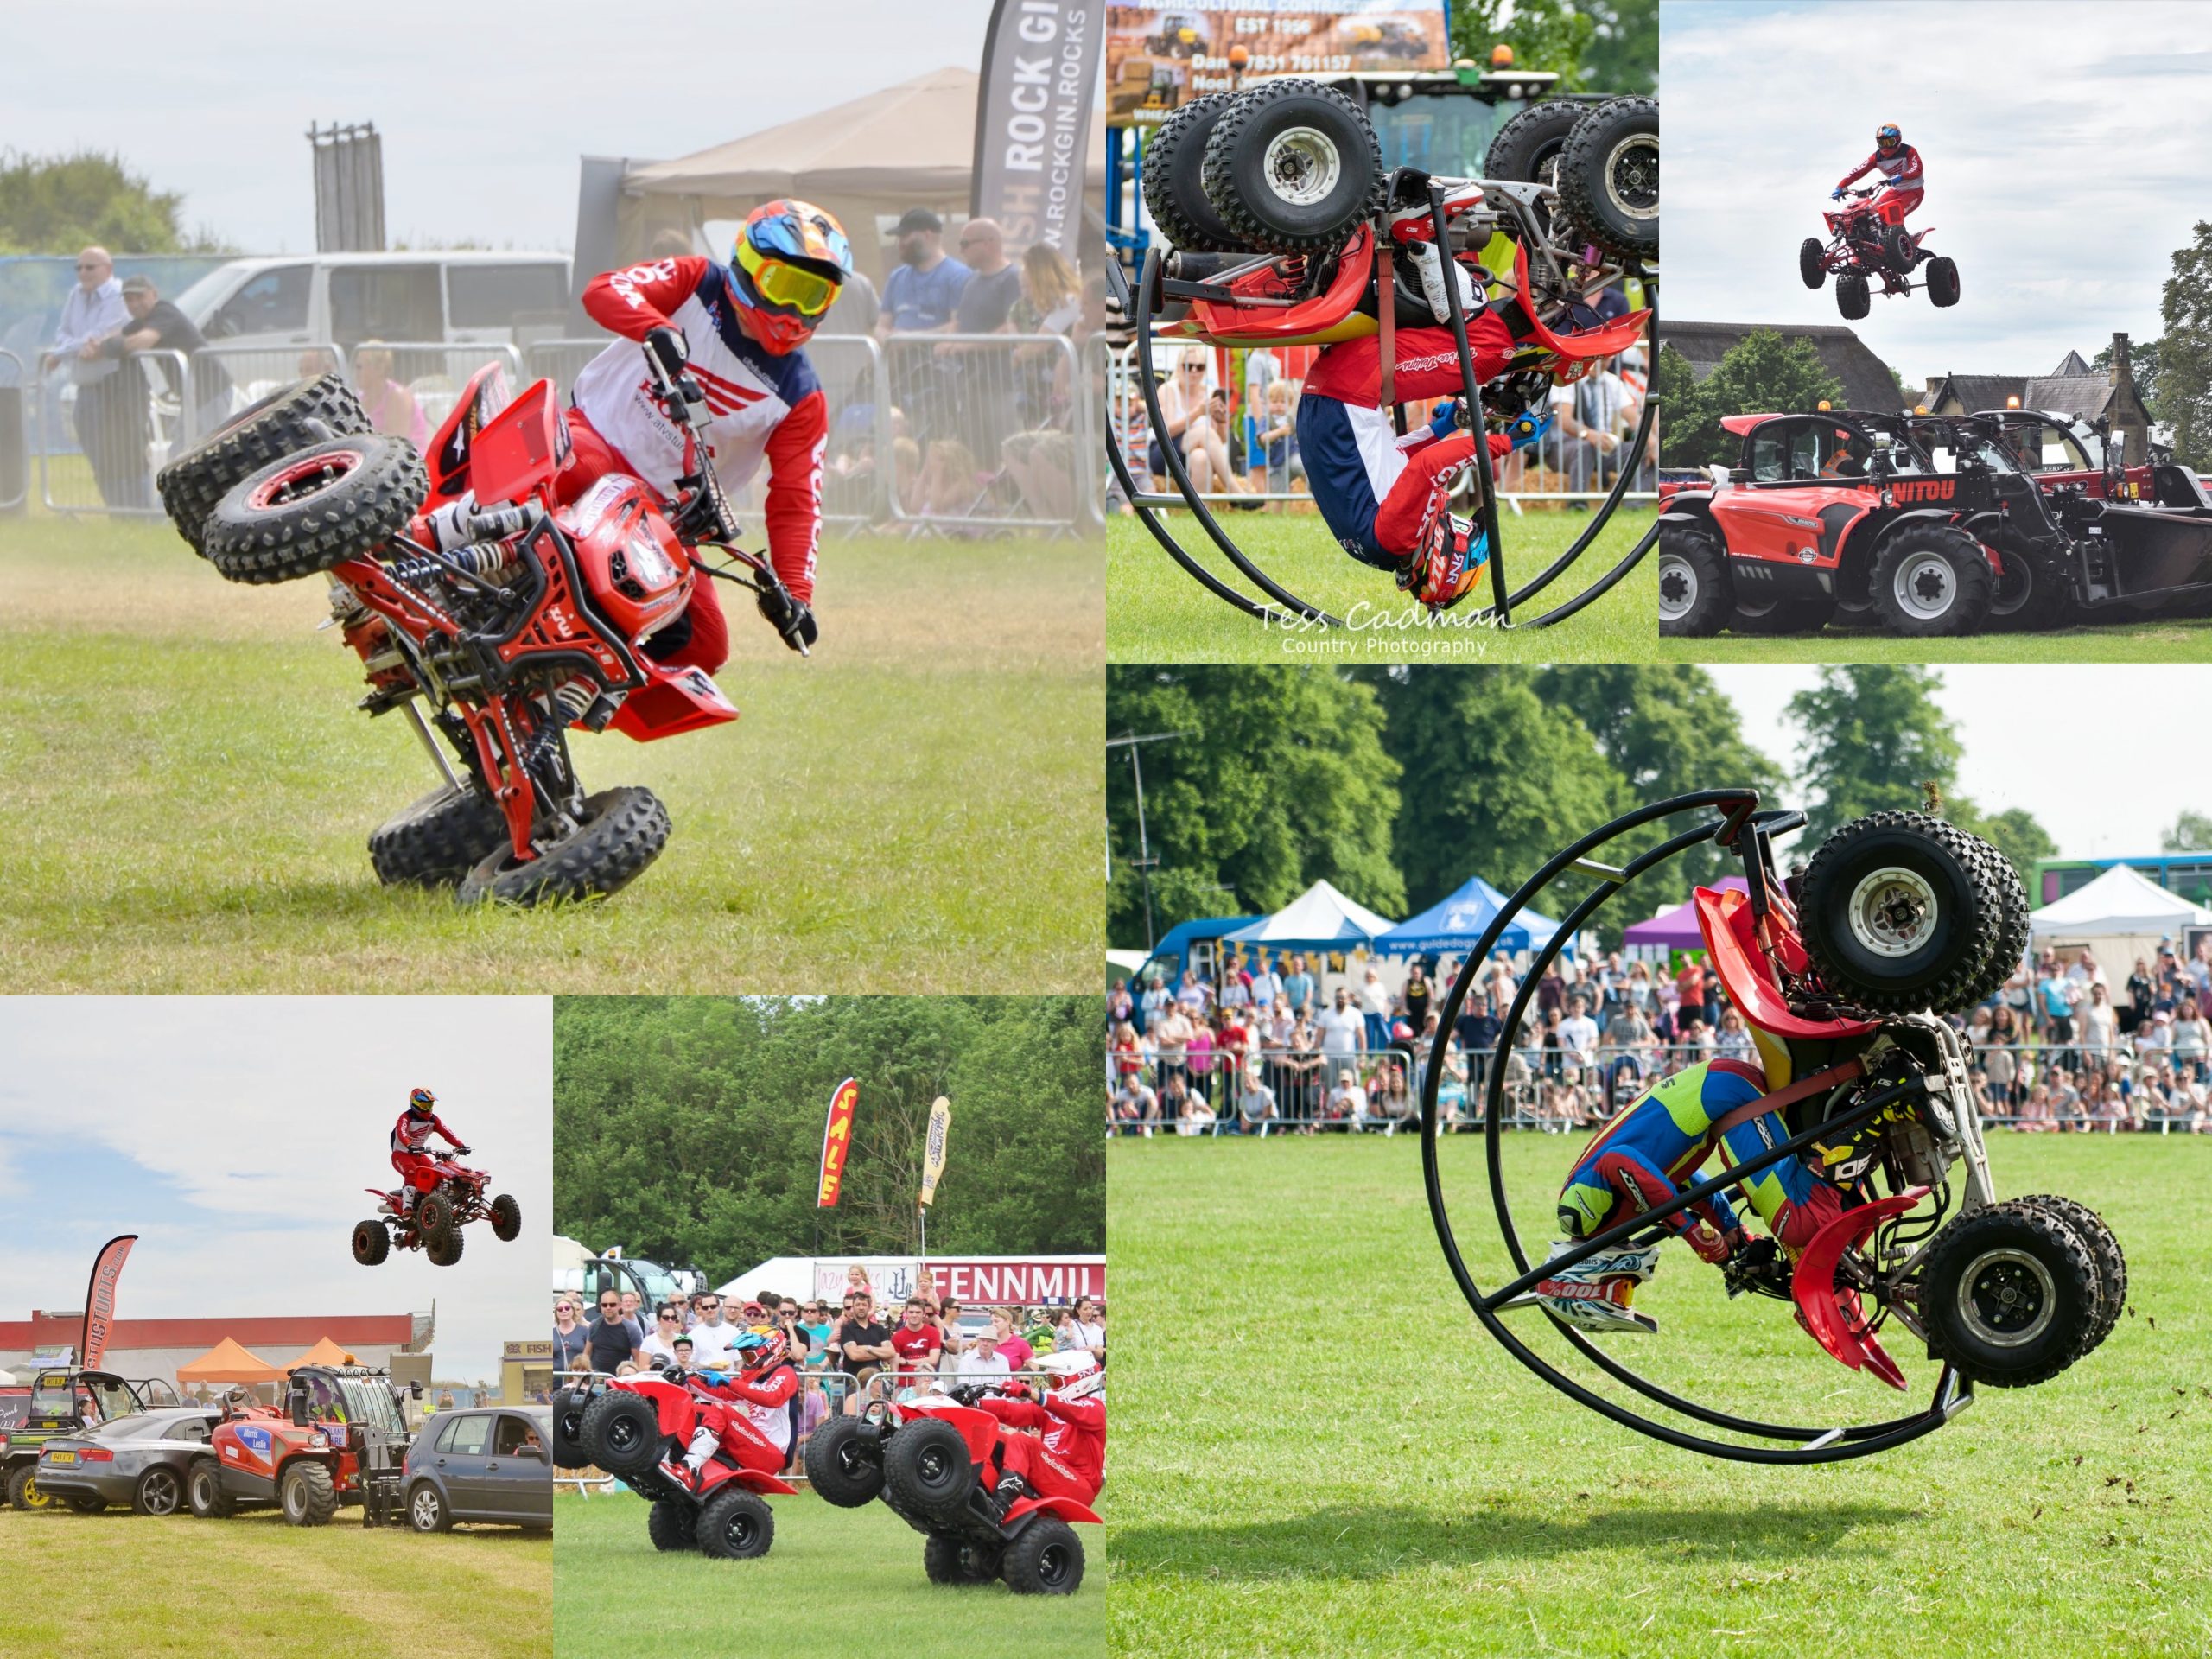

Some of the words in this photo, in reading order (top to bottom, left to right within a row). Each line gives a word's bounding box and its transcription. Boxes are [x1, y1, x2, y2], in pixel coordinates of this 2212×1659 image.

[1235, 17, 1268, 33] EST
[1192, 53, 1229, 70] Dan
[1246, 54, 1285, 70] 7831
[1291, 54, 1352, 71] 761157
[1005, 55, 1053, 172] ROCK
[1858, 480, 1955, 503] MNITOU
[820, 1088, 858, 1200] SALE
[928, 1266, 1106, 1301] FENNMIL
[1548, 1282, 1602, 1297] 100%
[526, 1344, 551, 1354] FISH
[243, 1428, 259, 1439] Morris
[252, 1440, 267, 1449] Leslie
